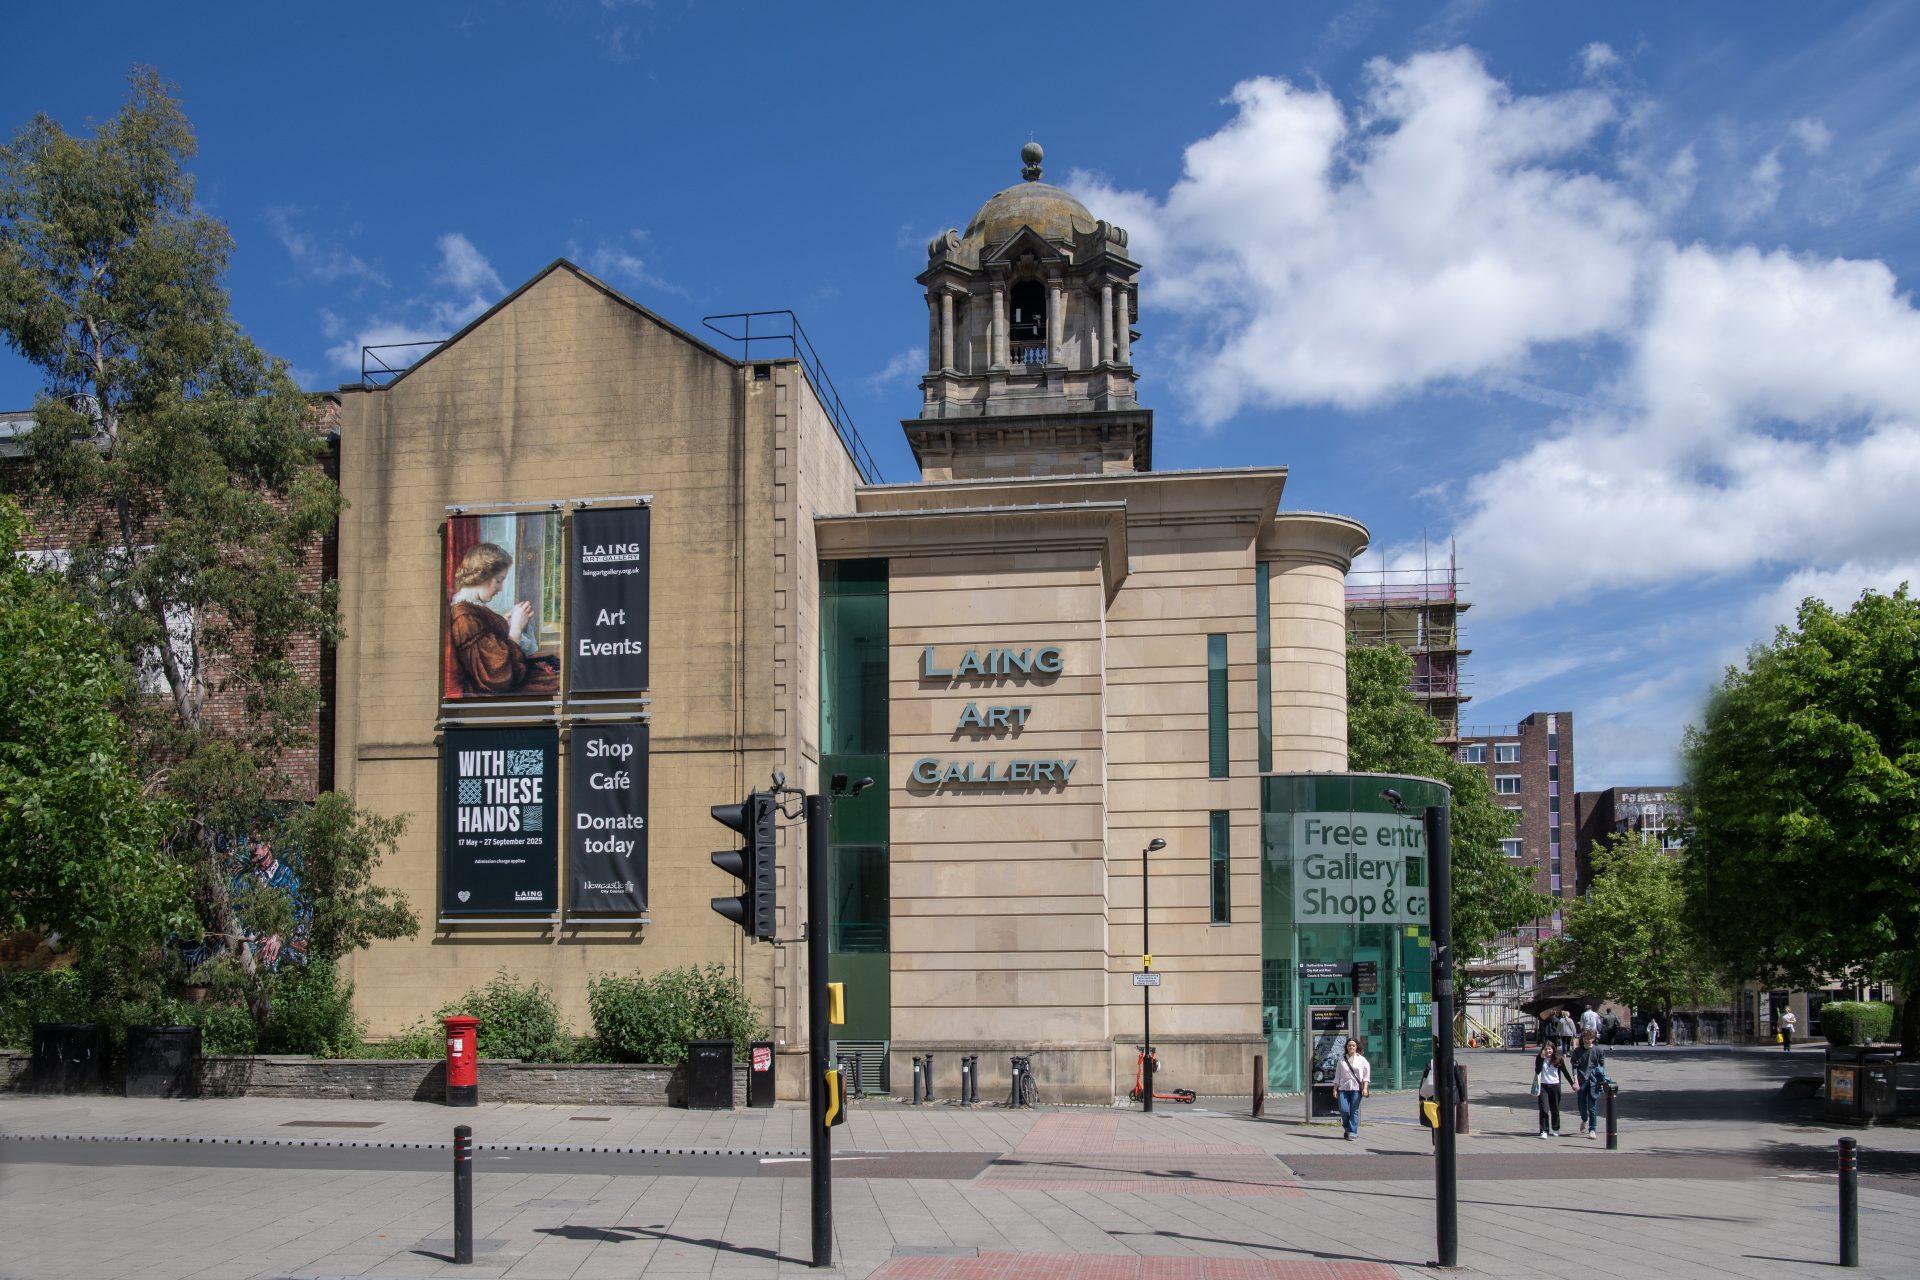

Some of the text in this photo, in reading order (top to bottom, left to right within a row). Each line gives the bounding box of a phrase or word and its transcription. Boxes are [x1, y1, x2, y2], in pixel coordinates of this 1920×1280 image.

[583, 543, 640, 555] LAING
[603, 554, 638, 562] GALLERY
[583, 567, 640, 577] laingartgallery.org.uk
[595, 608, 626, 626] Art
[579, 638, 642, 656] Events
[924, 646, 1065, 677] LAING
[958, 702, 1032, 729] ART
[586, 739, 634, 761] Shop
[458, 750, 505, 777] WITH
[912, 757, 1078, 784] GALLERY
[589, 770, 631, 790] Café
[484, 777, 543, 804] THESE
[457, 806, 520, 833] HANDS
[577, 813, 644, 830] Donate
[458, 838, 465, 846] 17
[465, 838, 478, 847] May
[484, 838, 492, 846] 27
[492, 838, 525, 847] September
[526, 837, 543, 845] 2025
[1304, 819, 1368, 846] Free
[585, 835, 635, 857] today
[1303, 853, 1400, 887] Gallery
[584, 880, 624, 890] Newcastle
[1302, 888, 1376, 922] Shop
[1382, 888, 1399, 915] &
[1408, 992, 1423, 1004] WITH
[1416, 1004, 1432, 1015] THESE
[1408, 1016, 1427, 1028] HANDS
